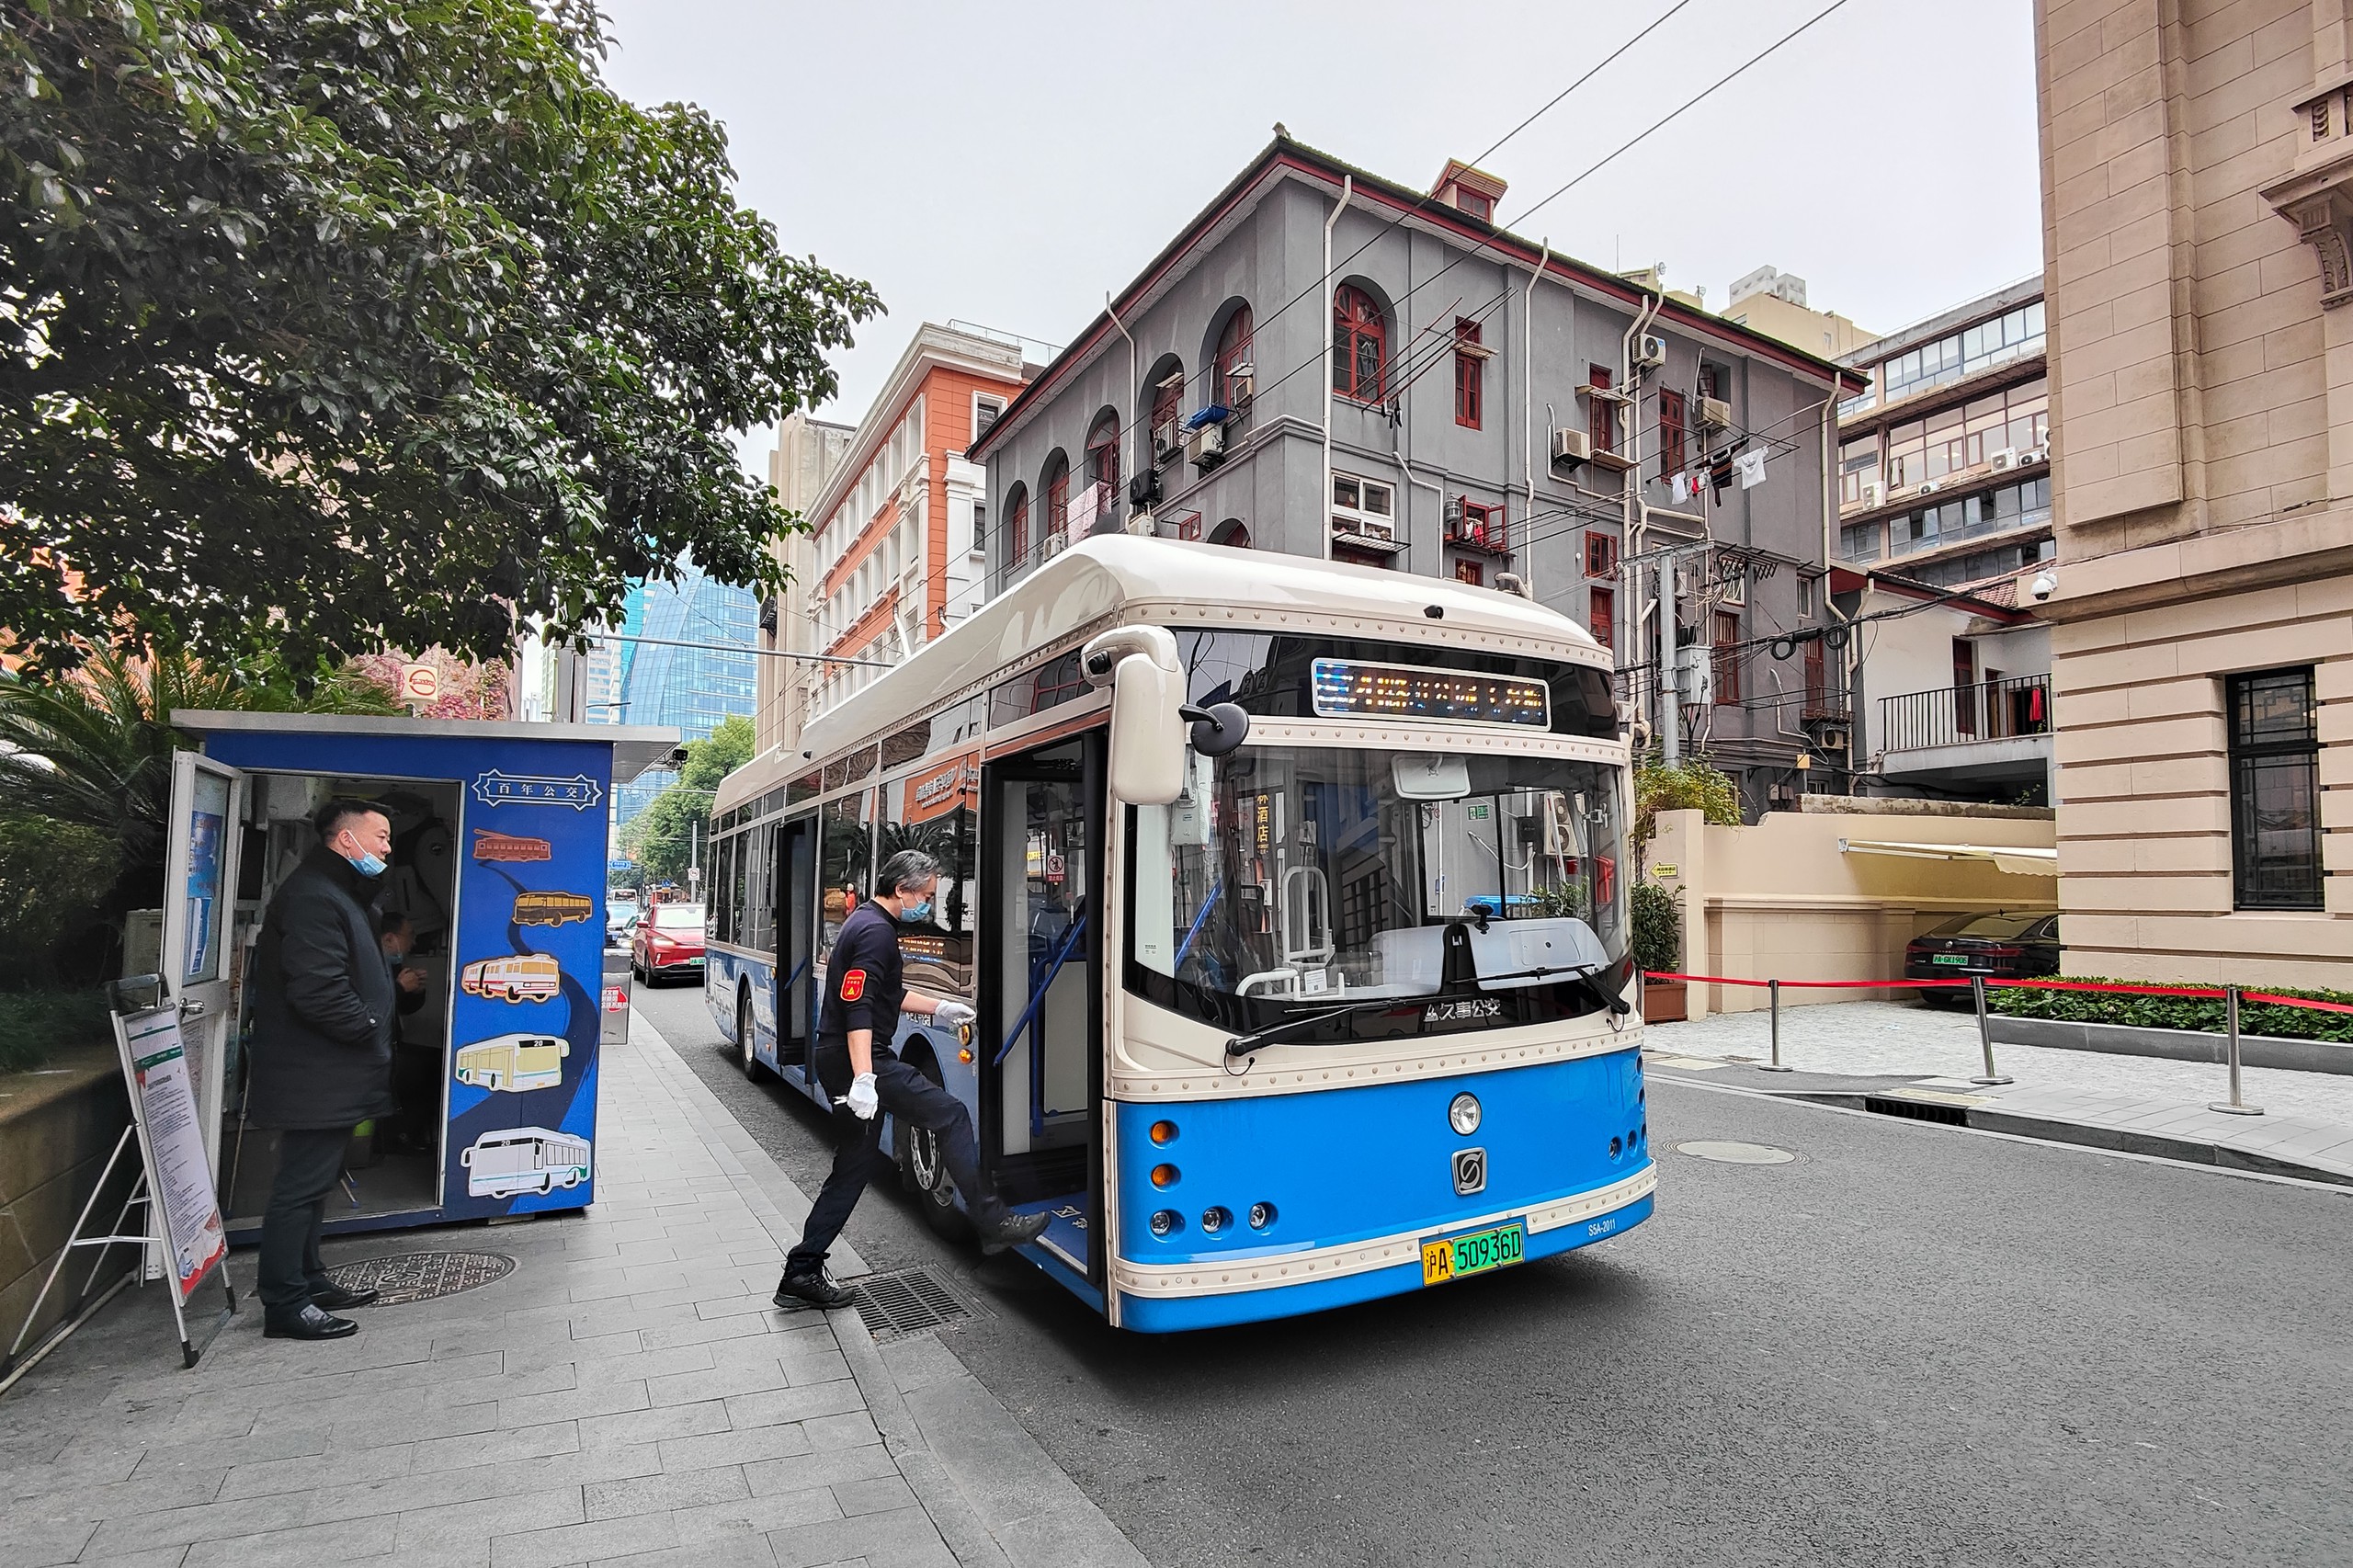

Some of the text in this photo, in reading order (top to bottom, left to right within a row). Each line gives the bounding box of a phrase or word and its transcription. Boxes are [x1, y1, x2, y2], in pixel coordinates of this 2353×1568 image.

[498, 782, 578, 798] 百年公交
[1438, 997, 1501, 1021] 久事公交
